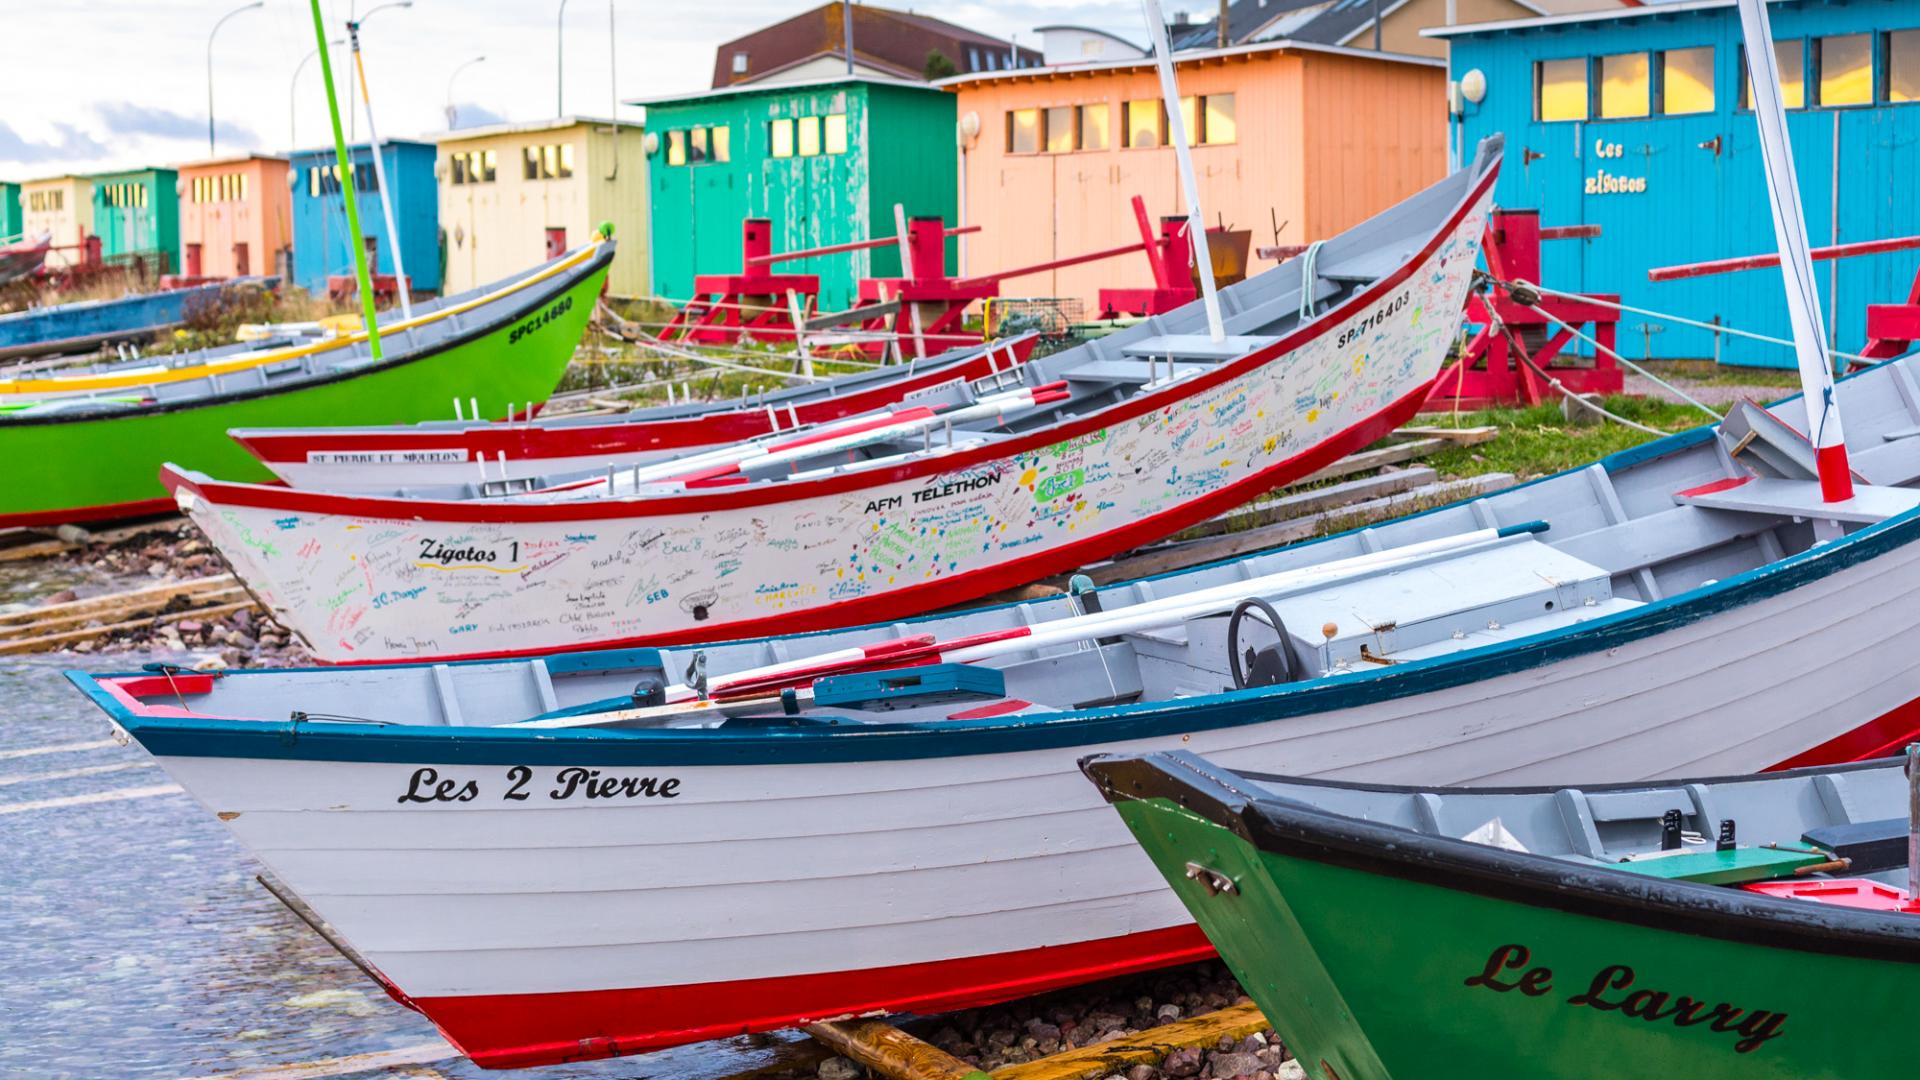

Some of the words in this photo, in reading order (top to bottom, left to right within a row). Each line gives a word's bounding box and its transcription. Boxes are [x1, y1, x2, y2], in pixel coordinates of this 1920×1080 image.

[1595, 138, 1624, 159] Les
[1360, 290, 1411, 337] 716403
[379, 453, 394, 463] ET
[864, 495, 903, 515] AFM
[911, 472, 1002, 504] TELETHON
[419, 538, 497, 565] Zigotos
[508, 541, 520, 563] 1
[646, 588, 670, 604] SEB
[449, 624, 479, 635] GARY
[397, 767, 479, 803] Les
[503, 765, 533, 801] 2
[549, 767, 681, 800] Pierre
[1463, 944, 1553, 996] Le
[1567, 965, 1789, 1053] Larry
